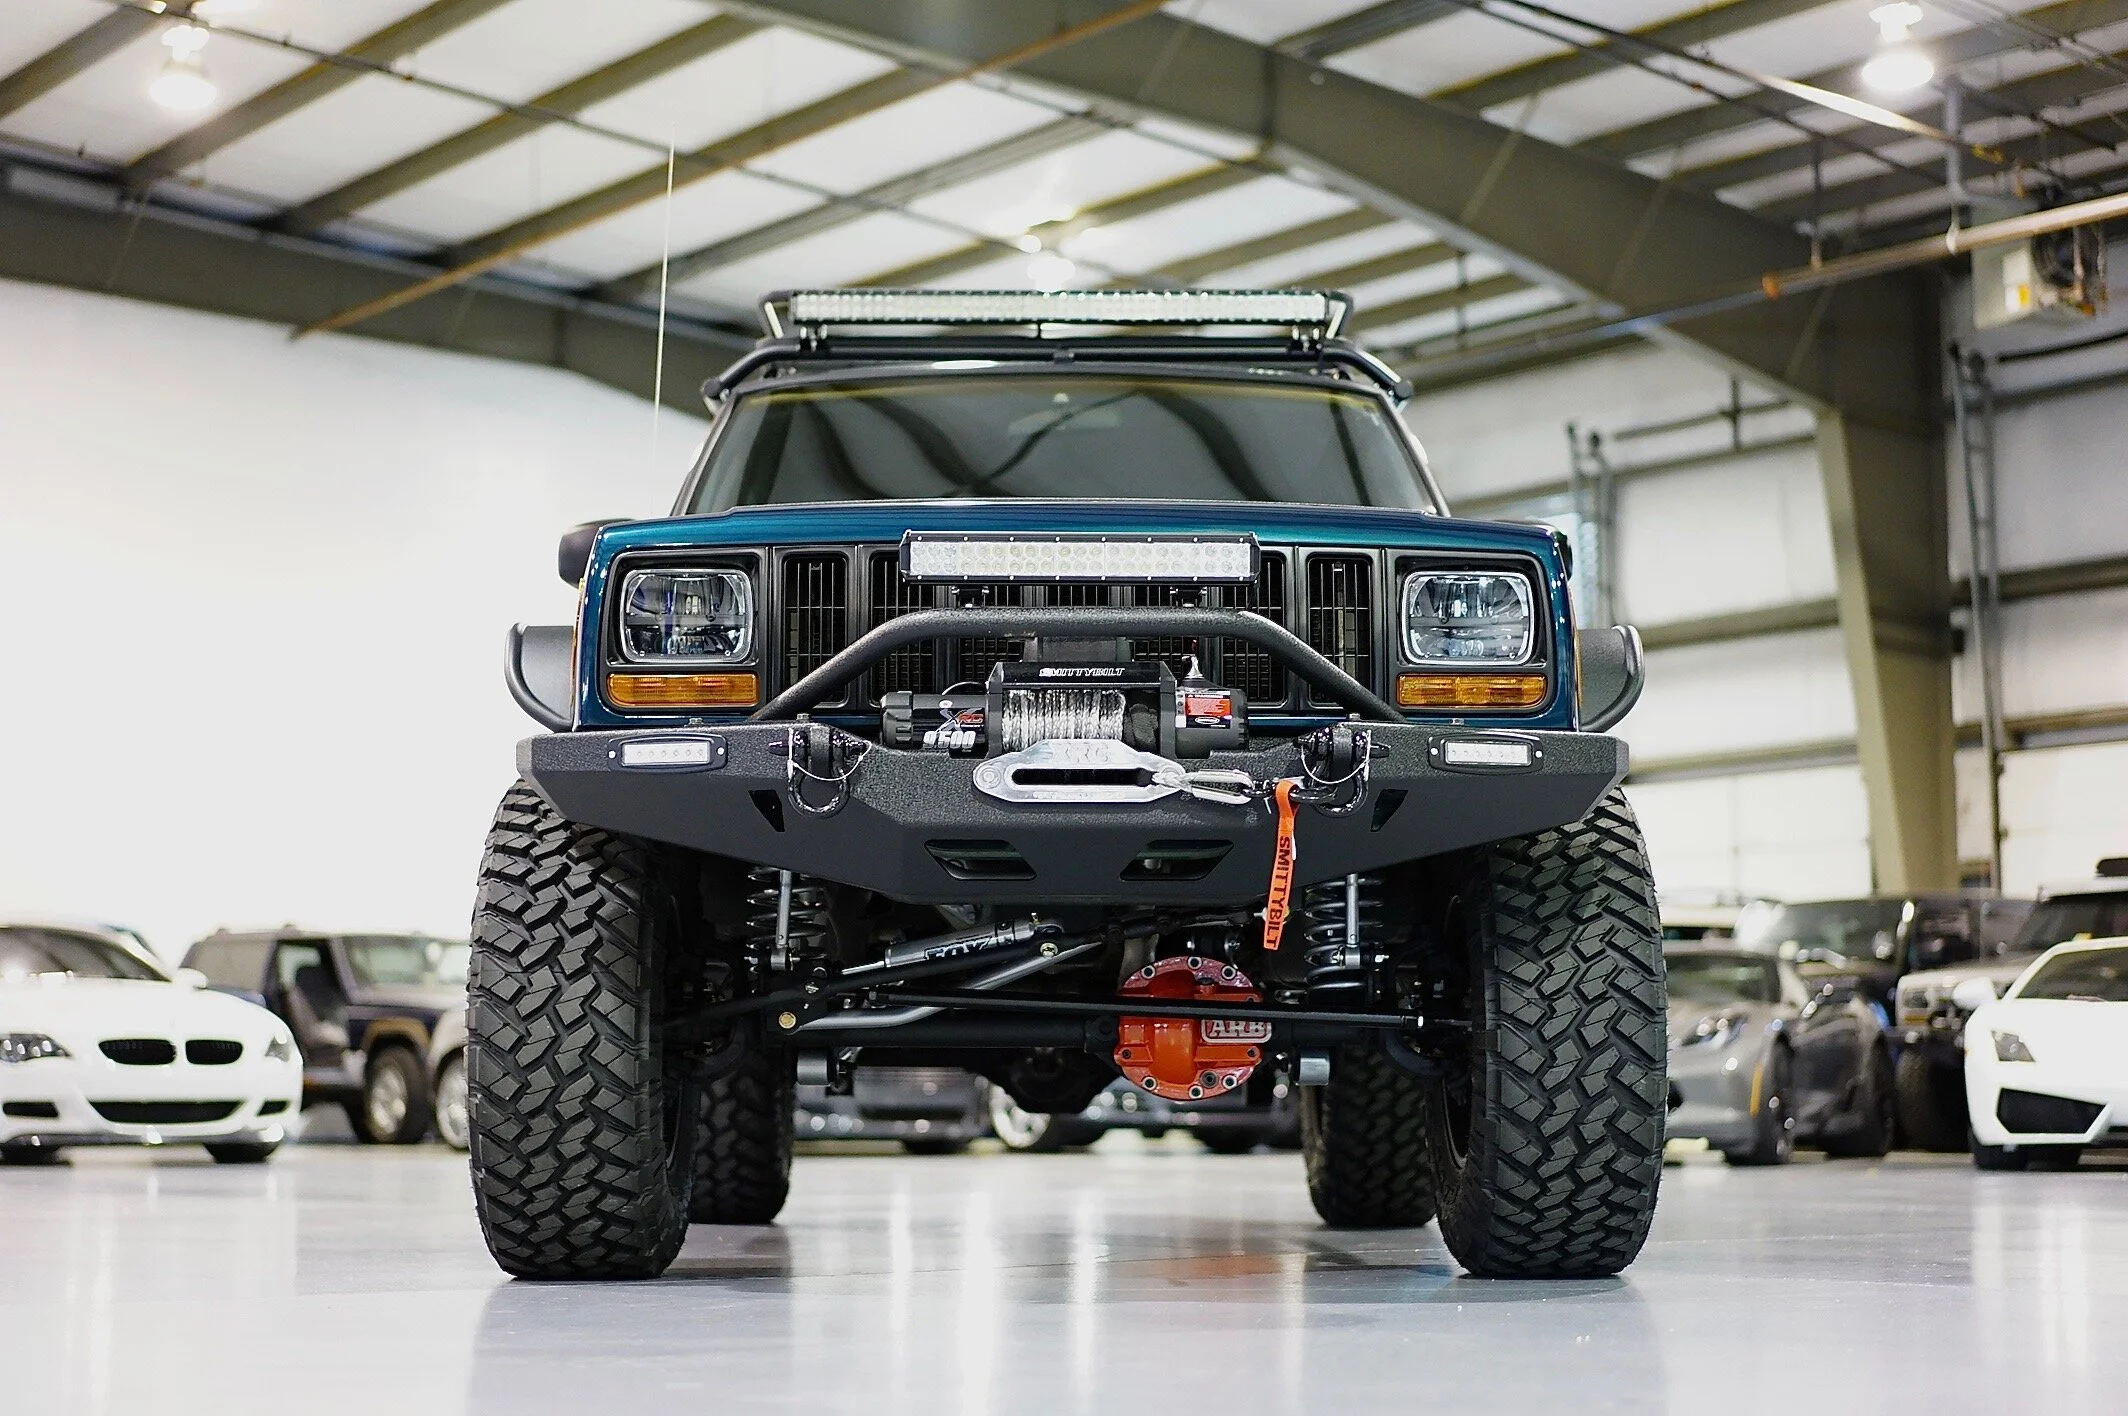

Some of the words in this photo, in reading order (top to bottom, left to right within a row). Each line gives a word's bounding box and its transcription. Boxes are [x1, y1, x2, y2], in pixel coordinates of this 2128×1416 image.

[923, 730, 976, 749] 9500
[1266, 835, 1290, 948] SMITTYBILT
[1209, 1020, 1267, 1038] ARB
